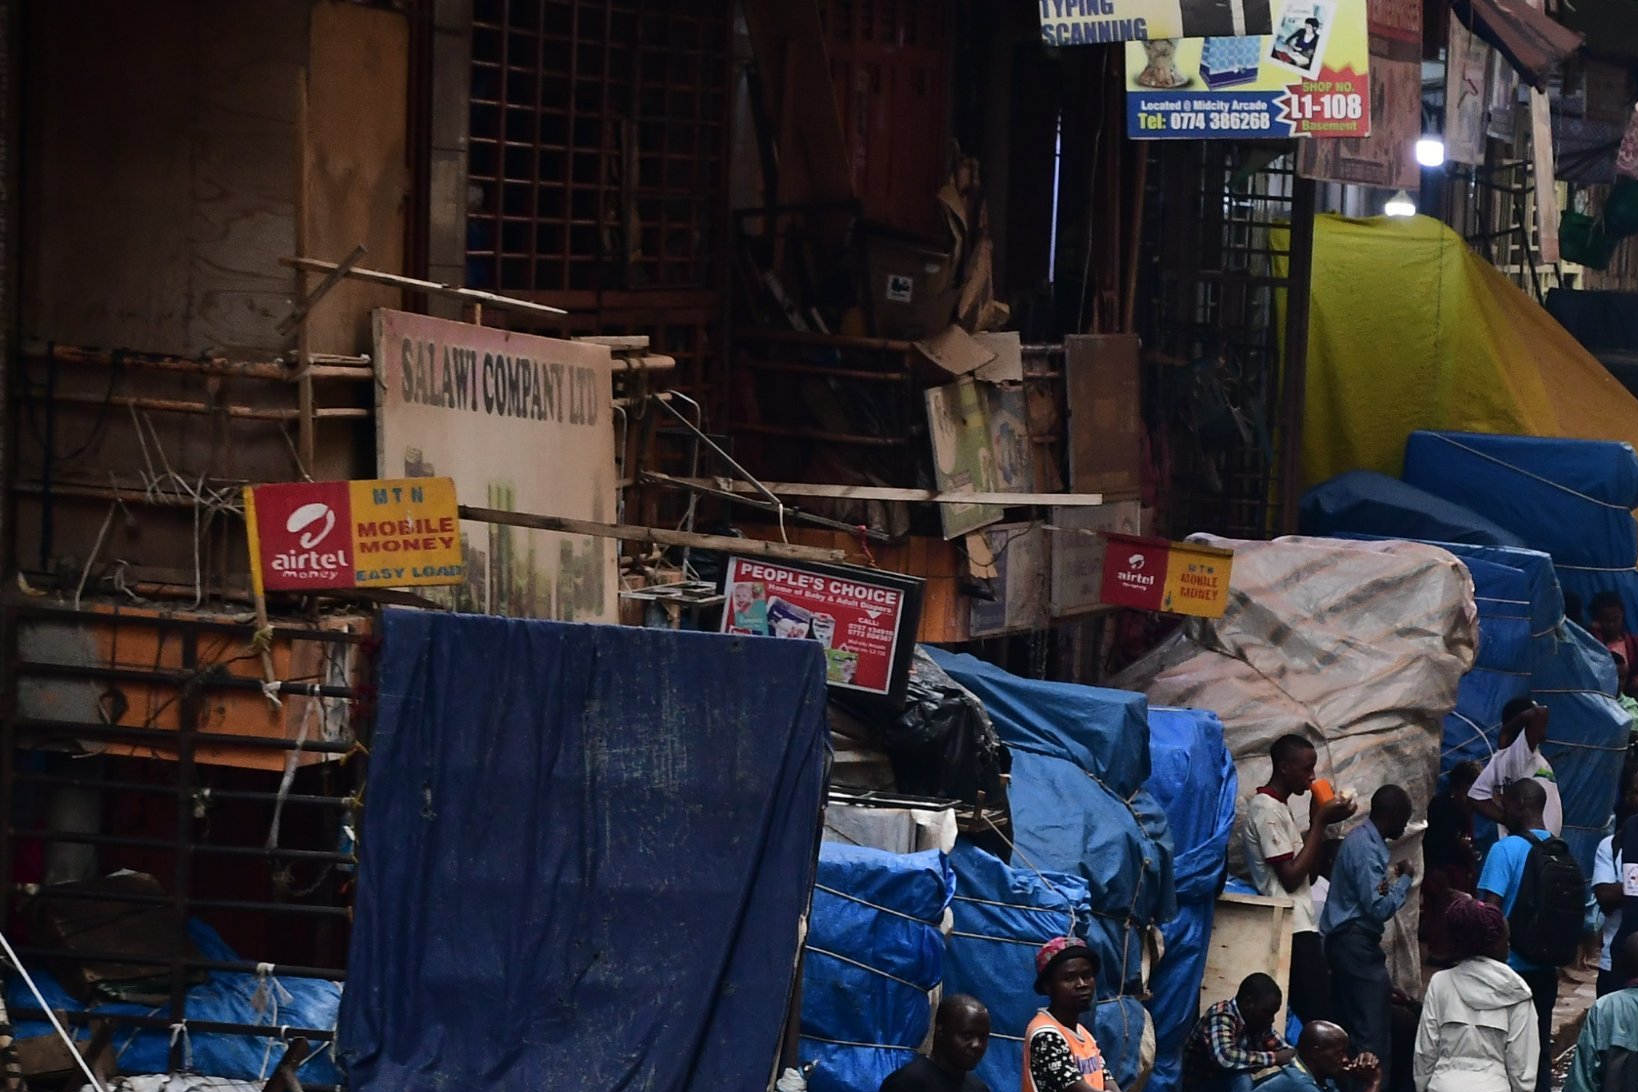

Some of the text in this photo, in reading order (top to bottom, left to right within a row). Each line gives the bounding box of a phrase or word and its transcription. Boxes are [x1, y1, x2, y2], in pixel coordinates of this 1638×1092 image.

[1041, 18, 1148, 46] SCANNING
[1302, 81, 1355, 92] SHOP NO.
[1141, 100, 1181, 111] Located
[1193, 100, 1230, 113] Midcity
[1232, 101, 1268, 111] Arcade
[1290, 93, 1362, 119] L1-108
[1138, 113, 1271, 130] Tel: 0774 386268
[1302, 120, 1357, 131] Basement
[401, 337, 598, 426] SALAWI COMPANY LTD
[357, 517, 454, 538] MOBILE
[359, 537, 455, 554] MONEY
[271, 549, 349, 571] airtel
[282, 570, 339, 581] money
[355, 567, 405, 582] EASY
[1117, 571, 1154, 585] airtel
[1181, 573, 1218, 588] MOBILE
[741, 562, 898, 605] PEOPLE'S CHOICE
[768, 583, 793, 594] Home
[804, 590, 826, 602] Baby
[1180, 587, 1219, 601] MONEY
